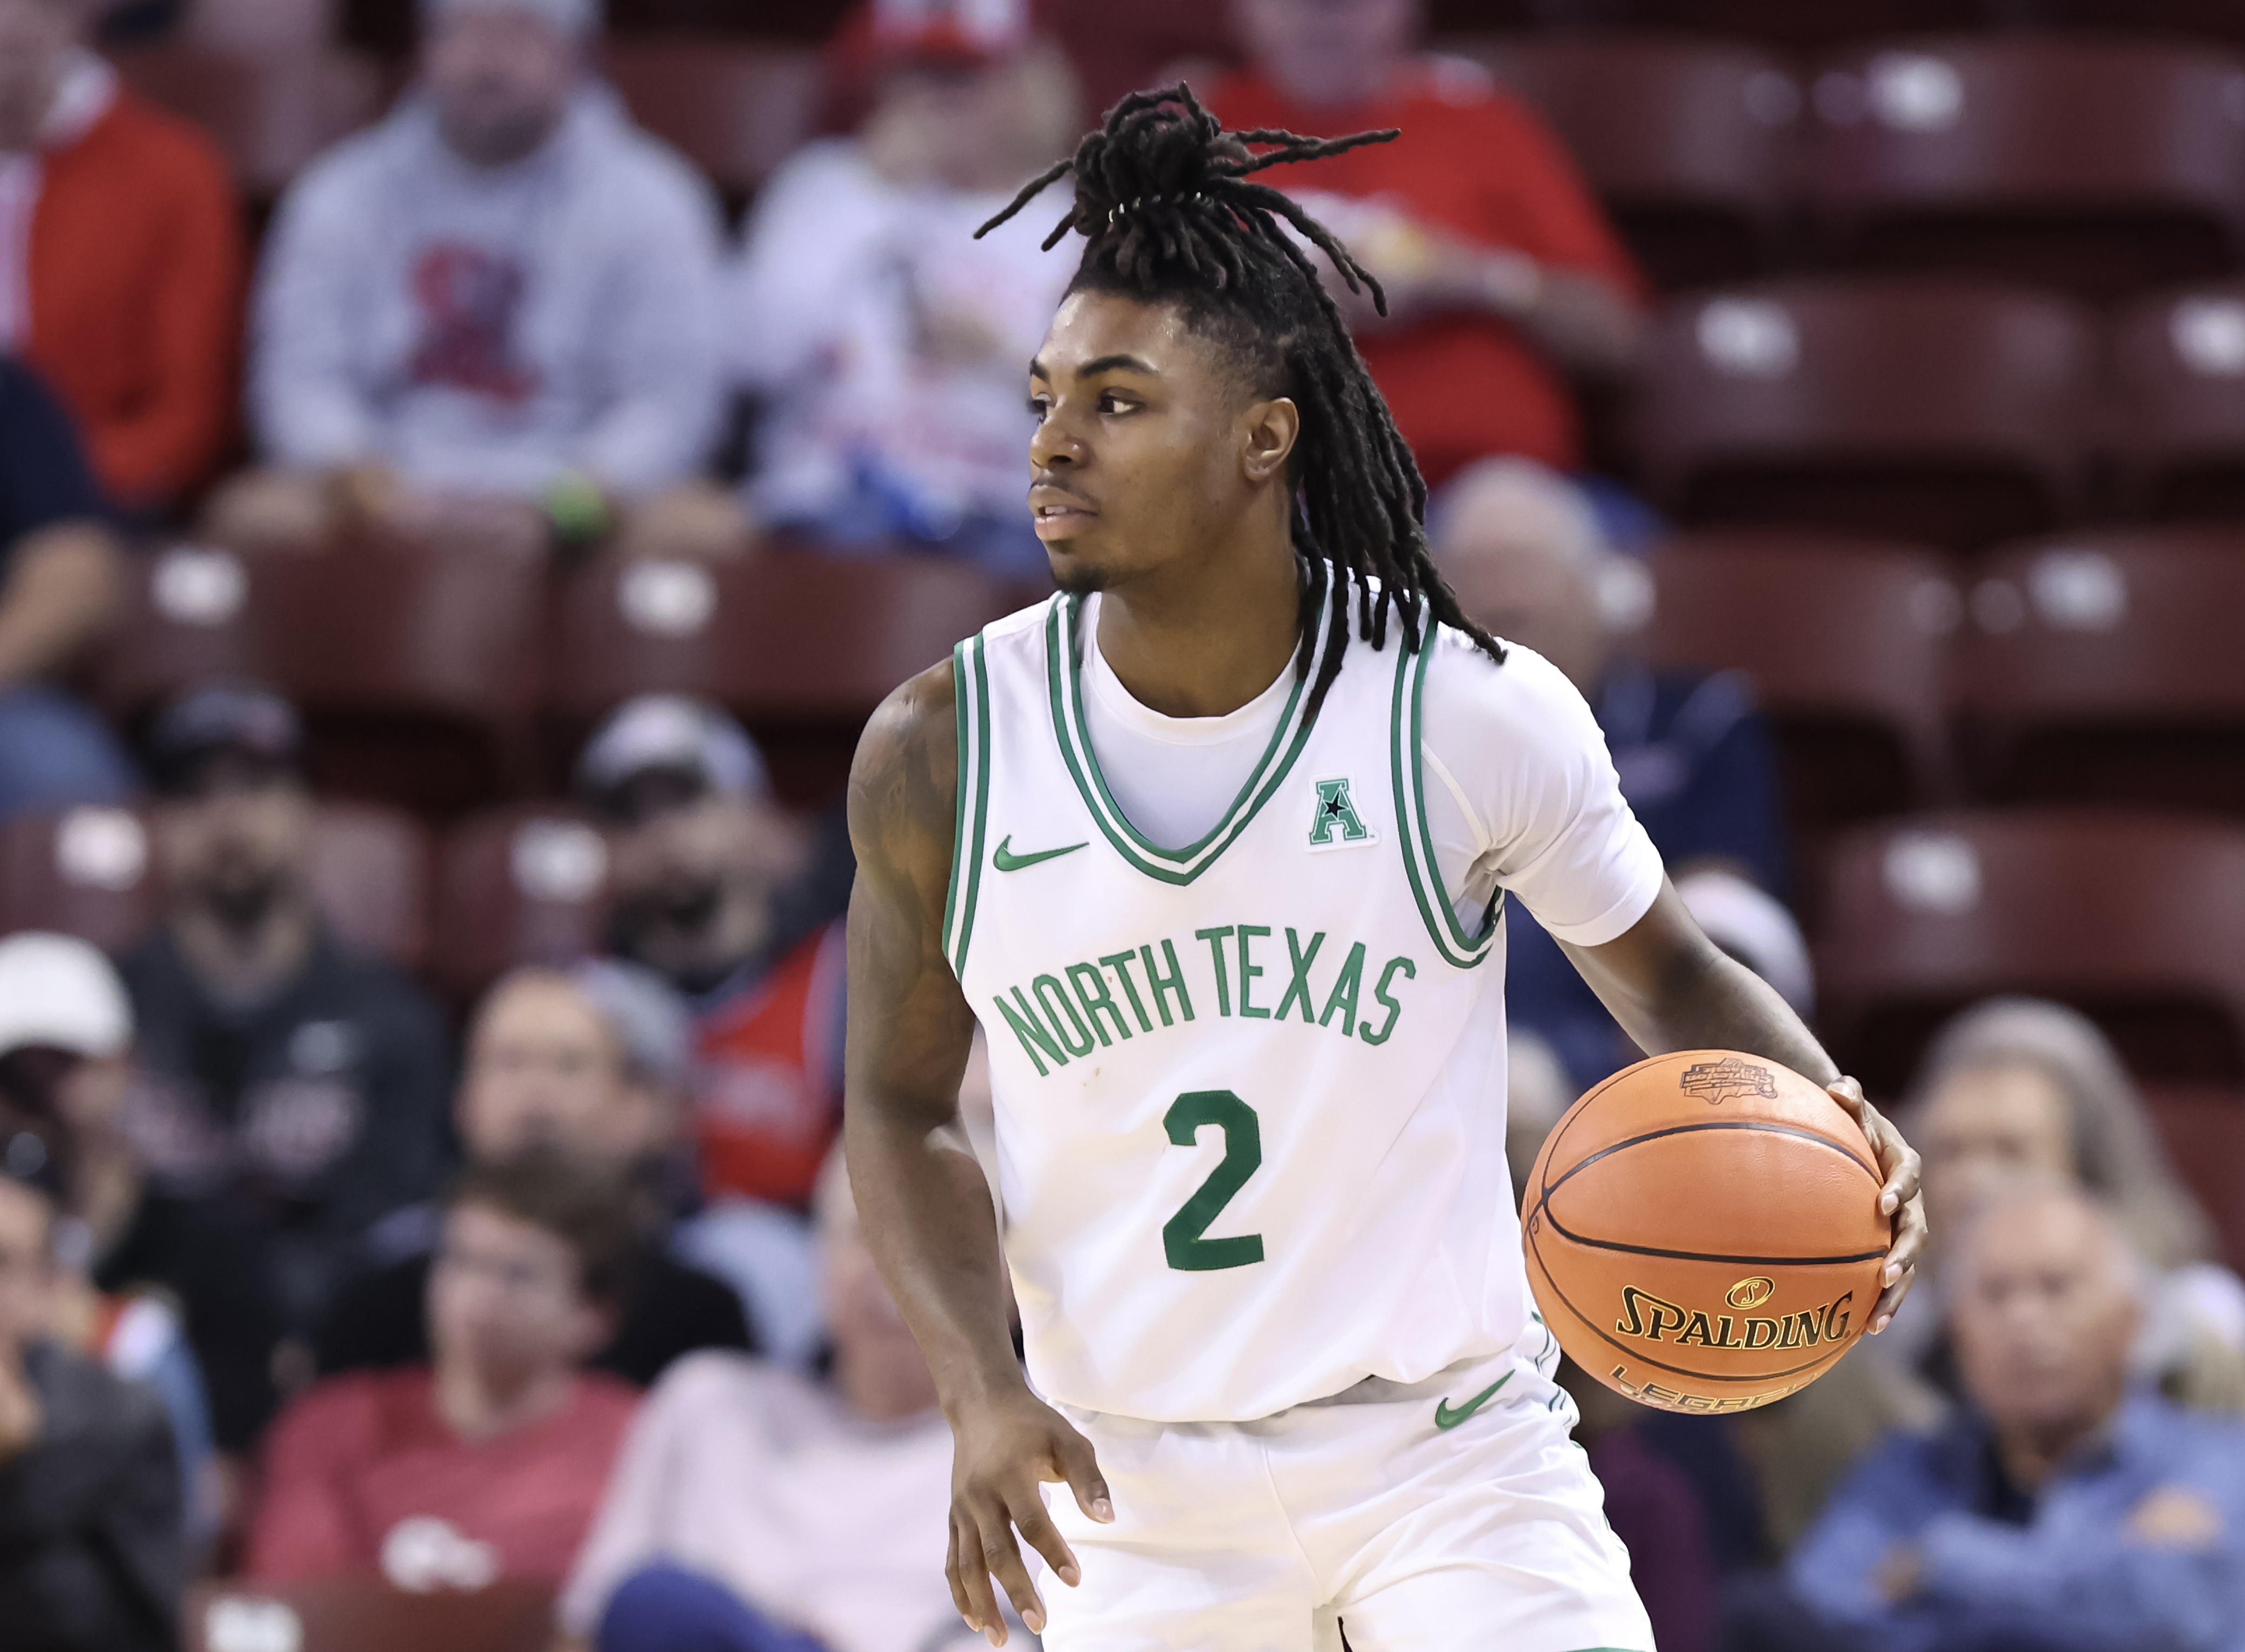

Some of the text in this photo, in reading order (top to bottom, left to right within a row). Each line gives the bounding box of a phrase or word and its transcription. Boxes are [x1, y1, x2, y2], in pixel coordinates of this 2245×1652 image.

[1309, 778, 1367, 845] A
[992, 924, 1416, 1077] NORTH TEXAS
[1163, 1090, 1264, 1272] 2
[1616, 1285, 1853, 1350] SPALDING
